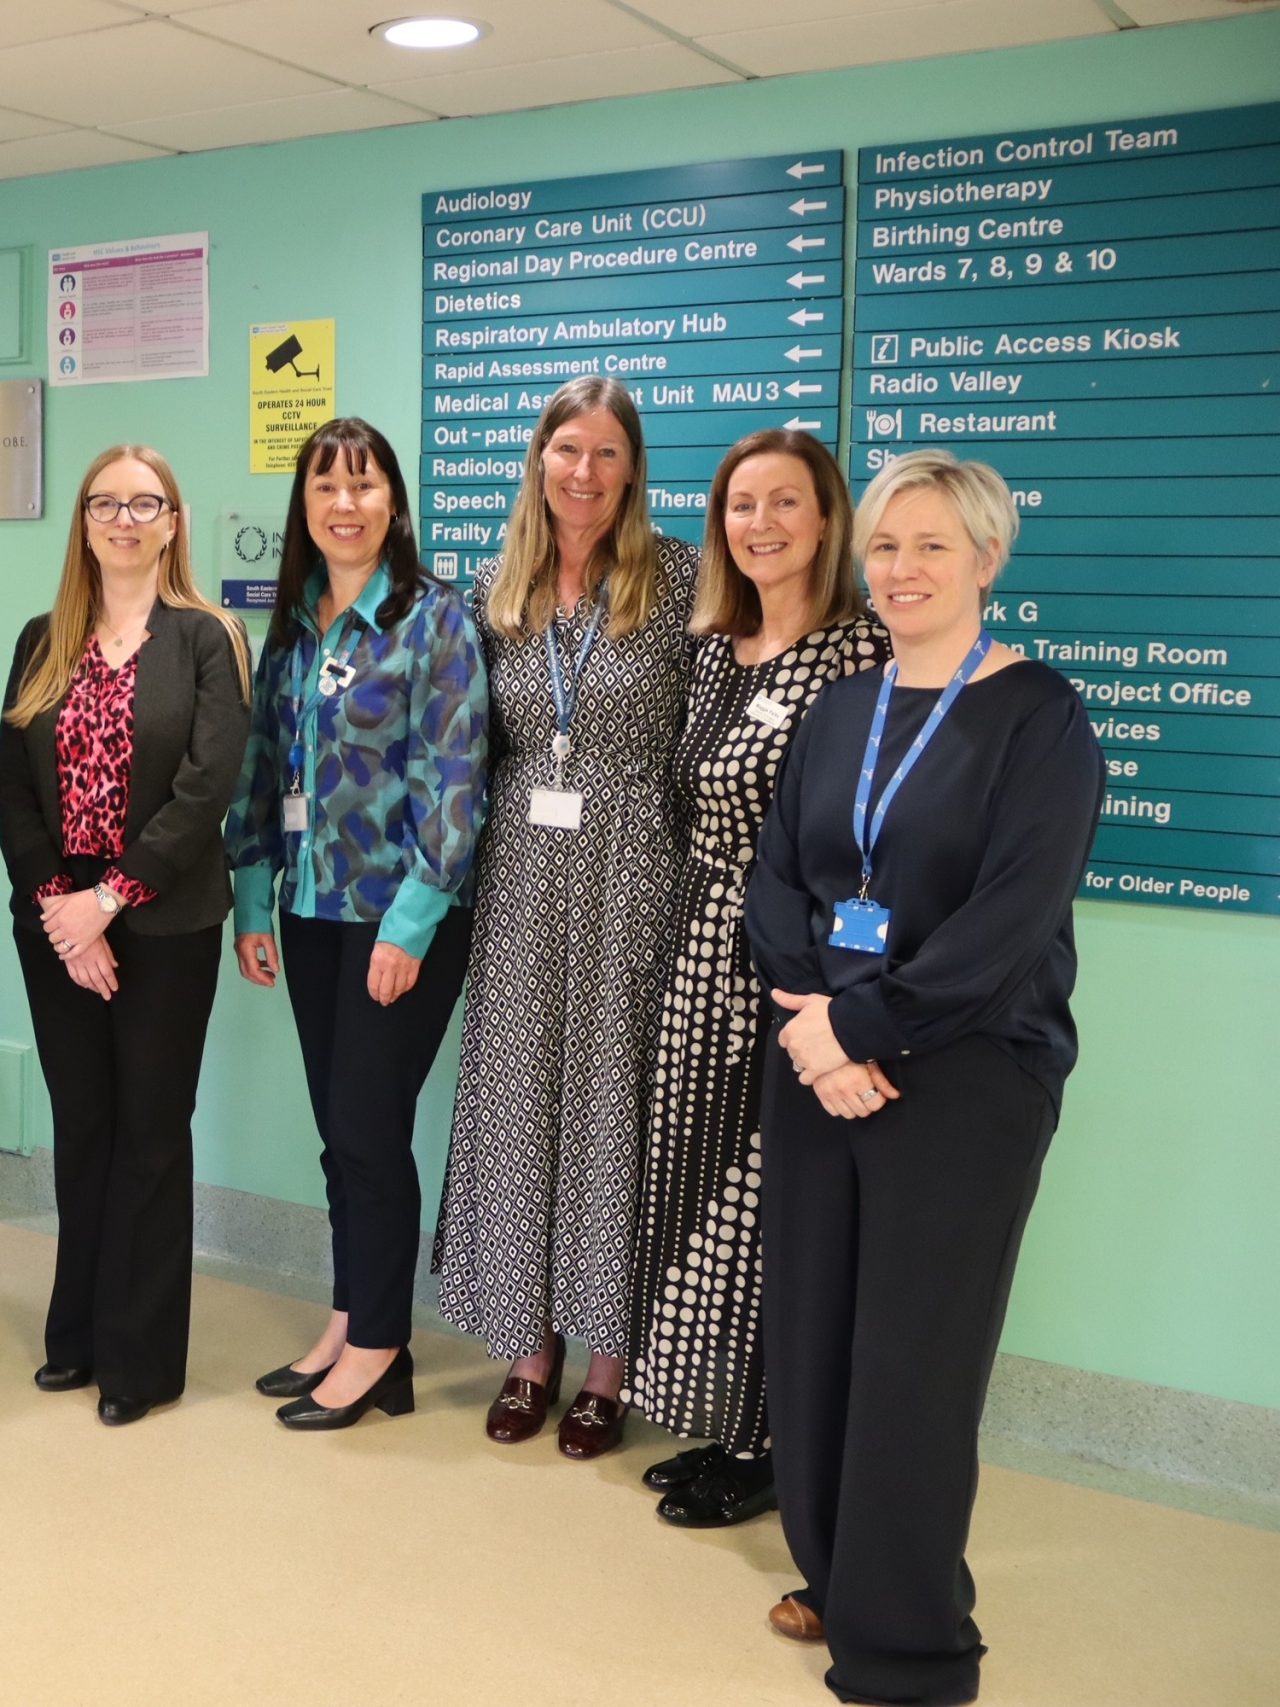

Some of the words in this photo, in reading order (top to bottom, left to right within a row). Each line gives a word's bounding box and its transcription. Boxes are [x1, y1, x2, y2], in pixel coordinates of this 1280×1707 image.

[876, 147, 983, 173] Infection
[996, 133, 1092, 162] Control
[1105, 129, 1177, 151] Team
[435, 191, 531, 213] Audiology
[875, 179, 1052, 211] Physiotherapy
[436, 225, 526, 248] Coronary
[535, 220, 582, 239] Care
[592, 213, 632, 234] Unit
[643, 204, 706, 231] (CCU)
[873, 223, 969, 247] Birthing
[978, 217, 1063, 240] Centre
[434, 256, 519, 283] Regional
[525, 255, 563, 276] Day
[570, 246, 677, 270] Procedure
[685, 240, 757, 261] Centre
[873, 261, 946, 284] Wards
[958, 258, 977, 282] 7,
[990, 256, 1012, 279] 8,
[1026, 254, 1042, 275] 9
[1055, 252, 1072, 273] &
[1087, 248, 1116, 270] 10
[436, 292, 521, 313] Dietetics
[436, 325, 548, 349] Respiratory
[553, 318, 675, 340] Ambulatory
[683, 313, 726, 333] Hub
[911, 336, 983, 357] Public
[995, 334, 1091, 354] Access
[1104, 327, 1180, 350] Kiosk
[436, 362, 484, 382] Rapid
[489, 356, 599, 378] Assessment
[605, 354, 667, 373] Centre
[870, 373, 938, 394] Radio
[950, 371, 1022, 394] Valley
[258, 400, 293, 409] OPERATES
[295, 400, 304, 408] 24
[306, 398, 326, 407] HOUR
[435, 393, 508, 413] Medical
[653, 385, 694, 405] Unit
[713, 383, 761, 402] MAU
[766, 381, 779, 401] 3
[266, 422, 317, 432] SURVEILLANCE
[282, 411, 301, 420] CCTV
[920, 411, 1056, 433] Restaurant
[434, 491, 506, 512] Speech
[432, 523, 491, 545] Frailty
[1019, 601, 1037, 622] G
[1034, 639, 1138, 667] Training
[1148, 643, 1227, 665] Room
[1170, 682, 1251, 706] Office
[1085, 872, 1114, 888] for
[1119, 875, 1174, 894] Older
[1180, 880, 1250, 902] People
